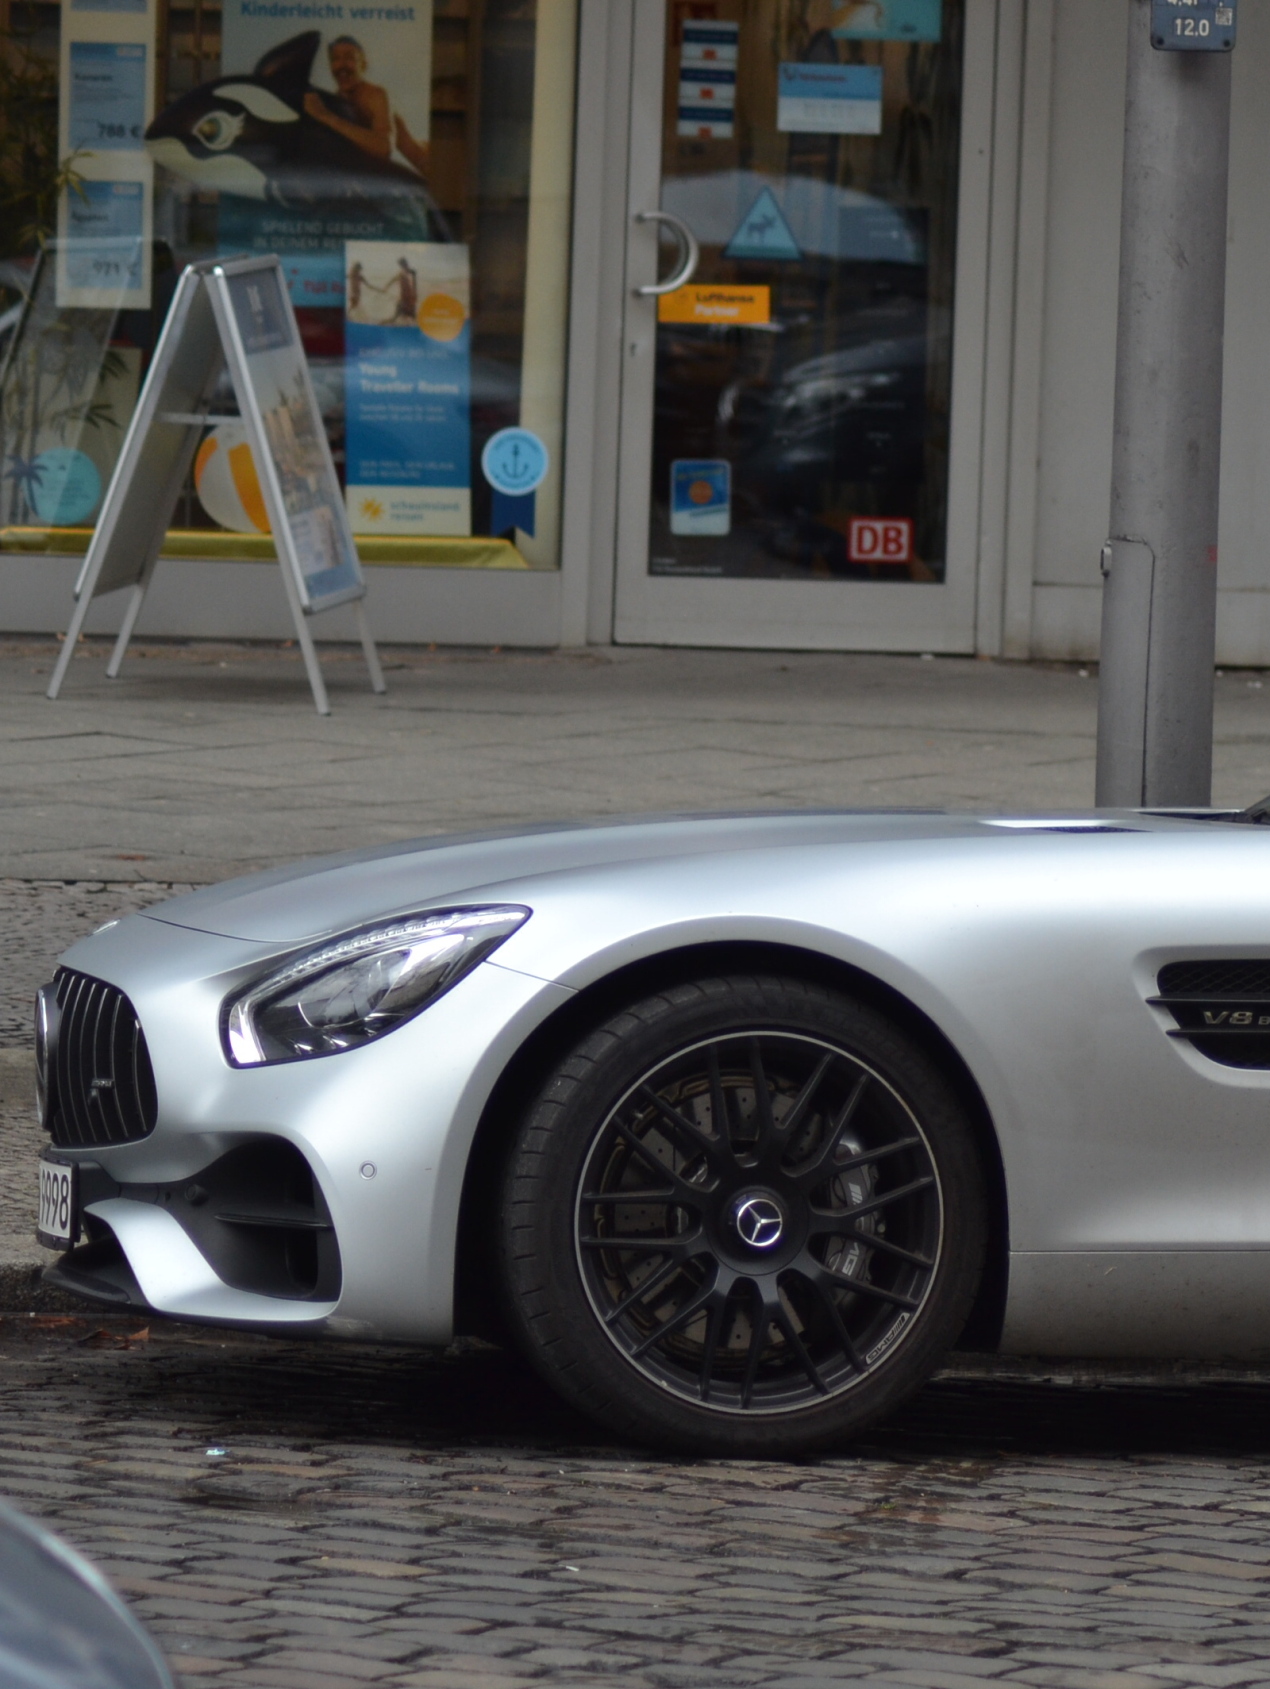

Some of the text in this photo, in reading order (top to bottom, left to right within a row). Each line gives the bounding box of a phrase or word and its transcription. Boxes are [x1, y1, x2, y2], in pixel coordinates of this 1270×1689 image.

[240, 2, 415, 20] Kinderleicht verreist
[1174, 18, 1210, 37] 12.0
[696, 291, 755, 304] Lufthansa
[695, 304, 739, 316] Partner
[857, 525, 904, 556] DB
[1203, 1011, 1253, 1026] V8
